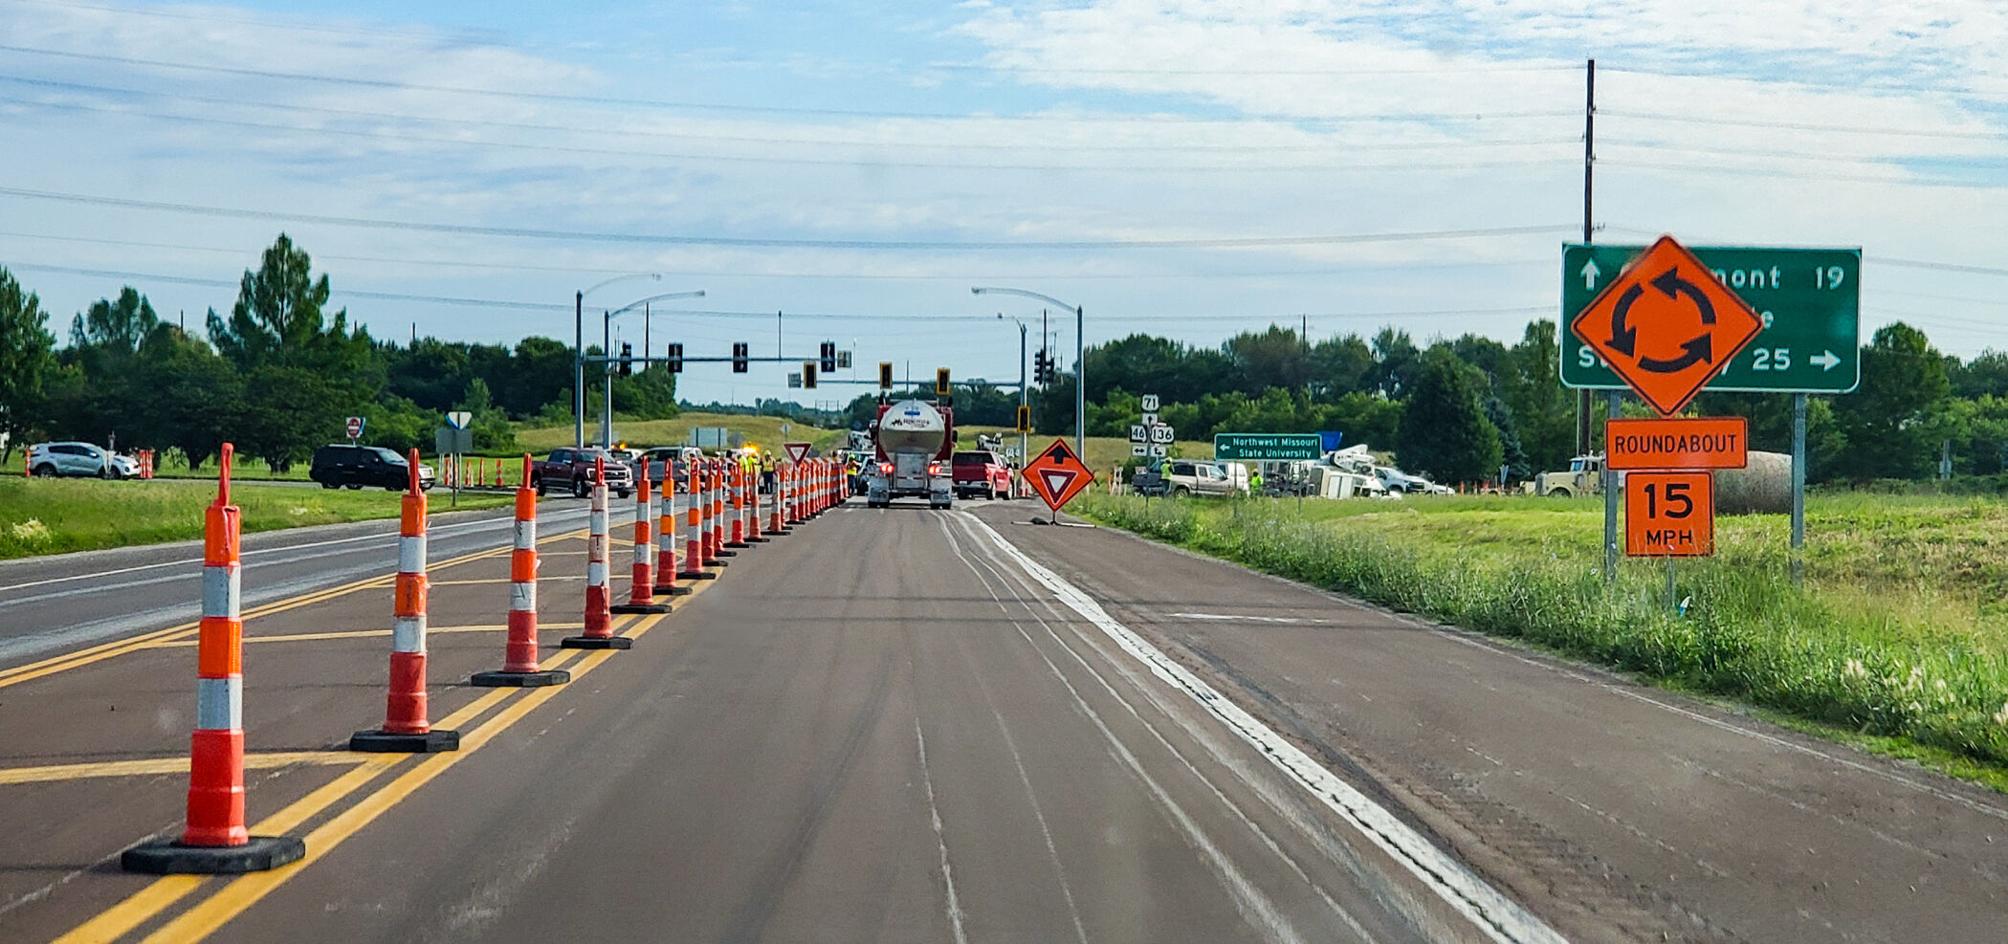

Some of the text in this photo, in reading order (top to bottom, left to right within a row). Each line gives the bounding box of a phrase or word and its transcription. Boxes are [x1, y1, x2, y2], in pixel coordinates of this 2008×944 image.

[1815, 266, 1844, 290] 19
[1752, 347, 1791, 371] 25
[1144, 397, 1156, 408] 71
[1132, 428, 1145, 438] 46
[1153, 429, 1172, 440] 136
[1233, 437, 1318, 447] Northwest Missouri
[1615, 435, 1737, 454] ROUNDABOUT
[1239, 448, 1312, 458] State University
[1644, 483, 1693, 519] 15
[1646, 529, 1693, 545] MPH
